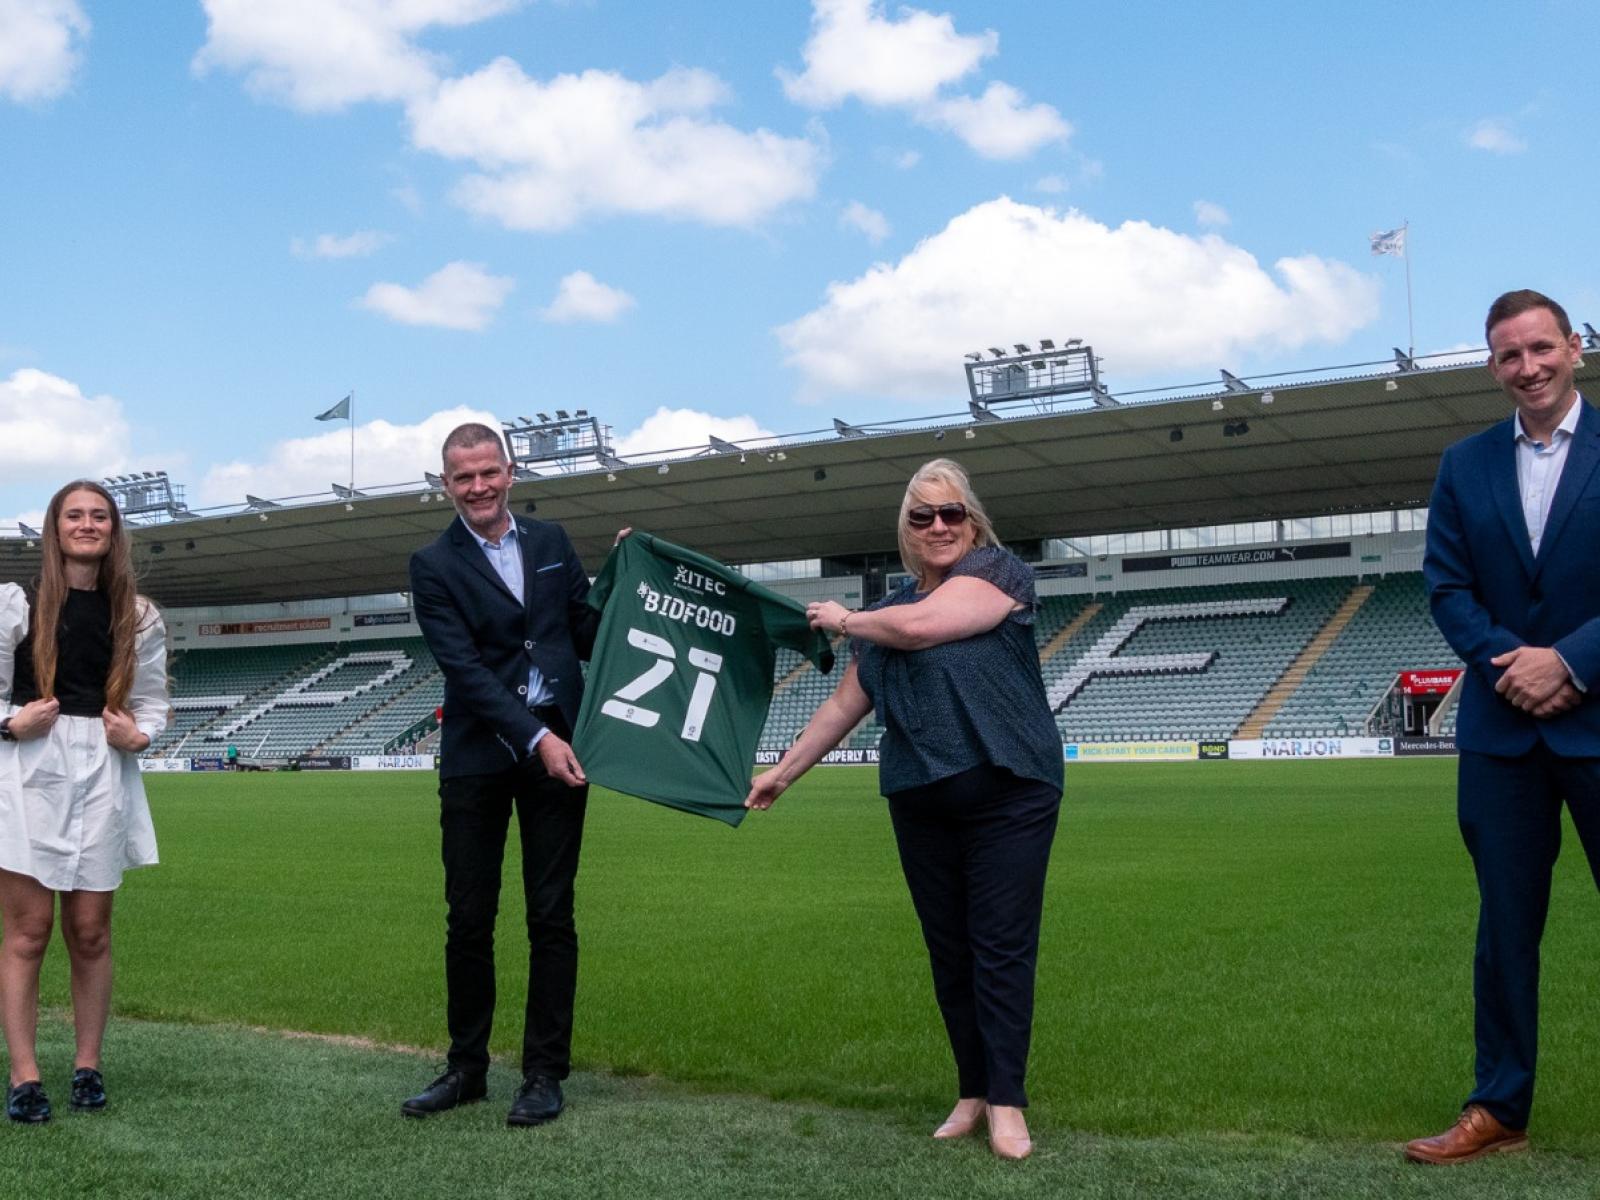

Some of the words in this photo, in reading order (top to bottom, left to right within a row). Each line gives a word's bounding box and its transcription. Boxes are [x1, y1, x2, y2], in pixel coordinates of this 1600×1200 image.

[601, 627, 723, 742] 21
[1262, 740, 1342, 756] MARJON
[1400, 741, 1457, 750] Mercedes-Ben
